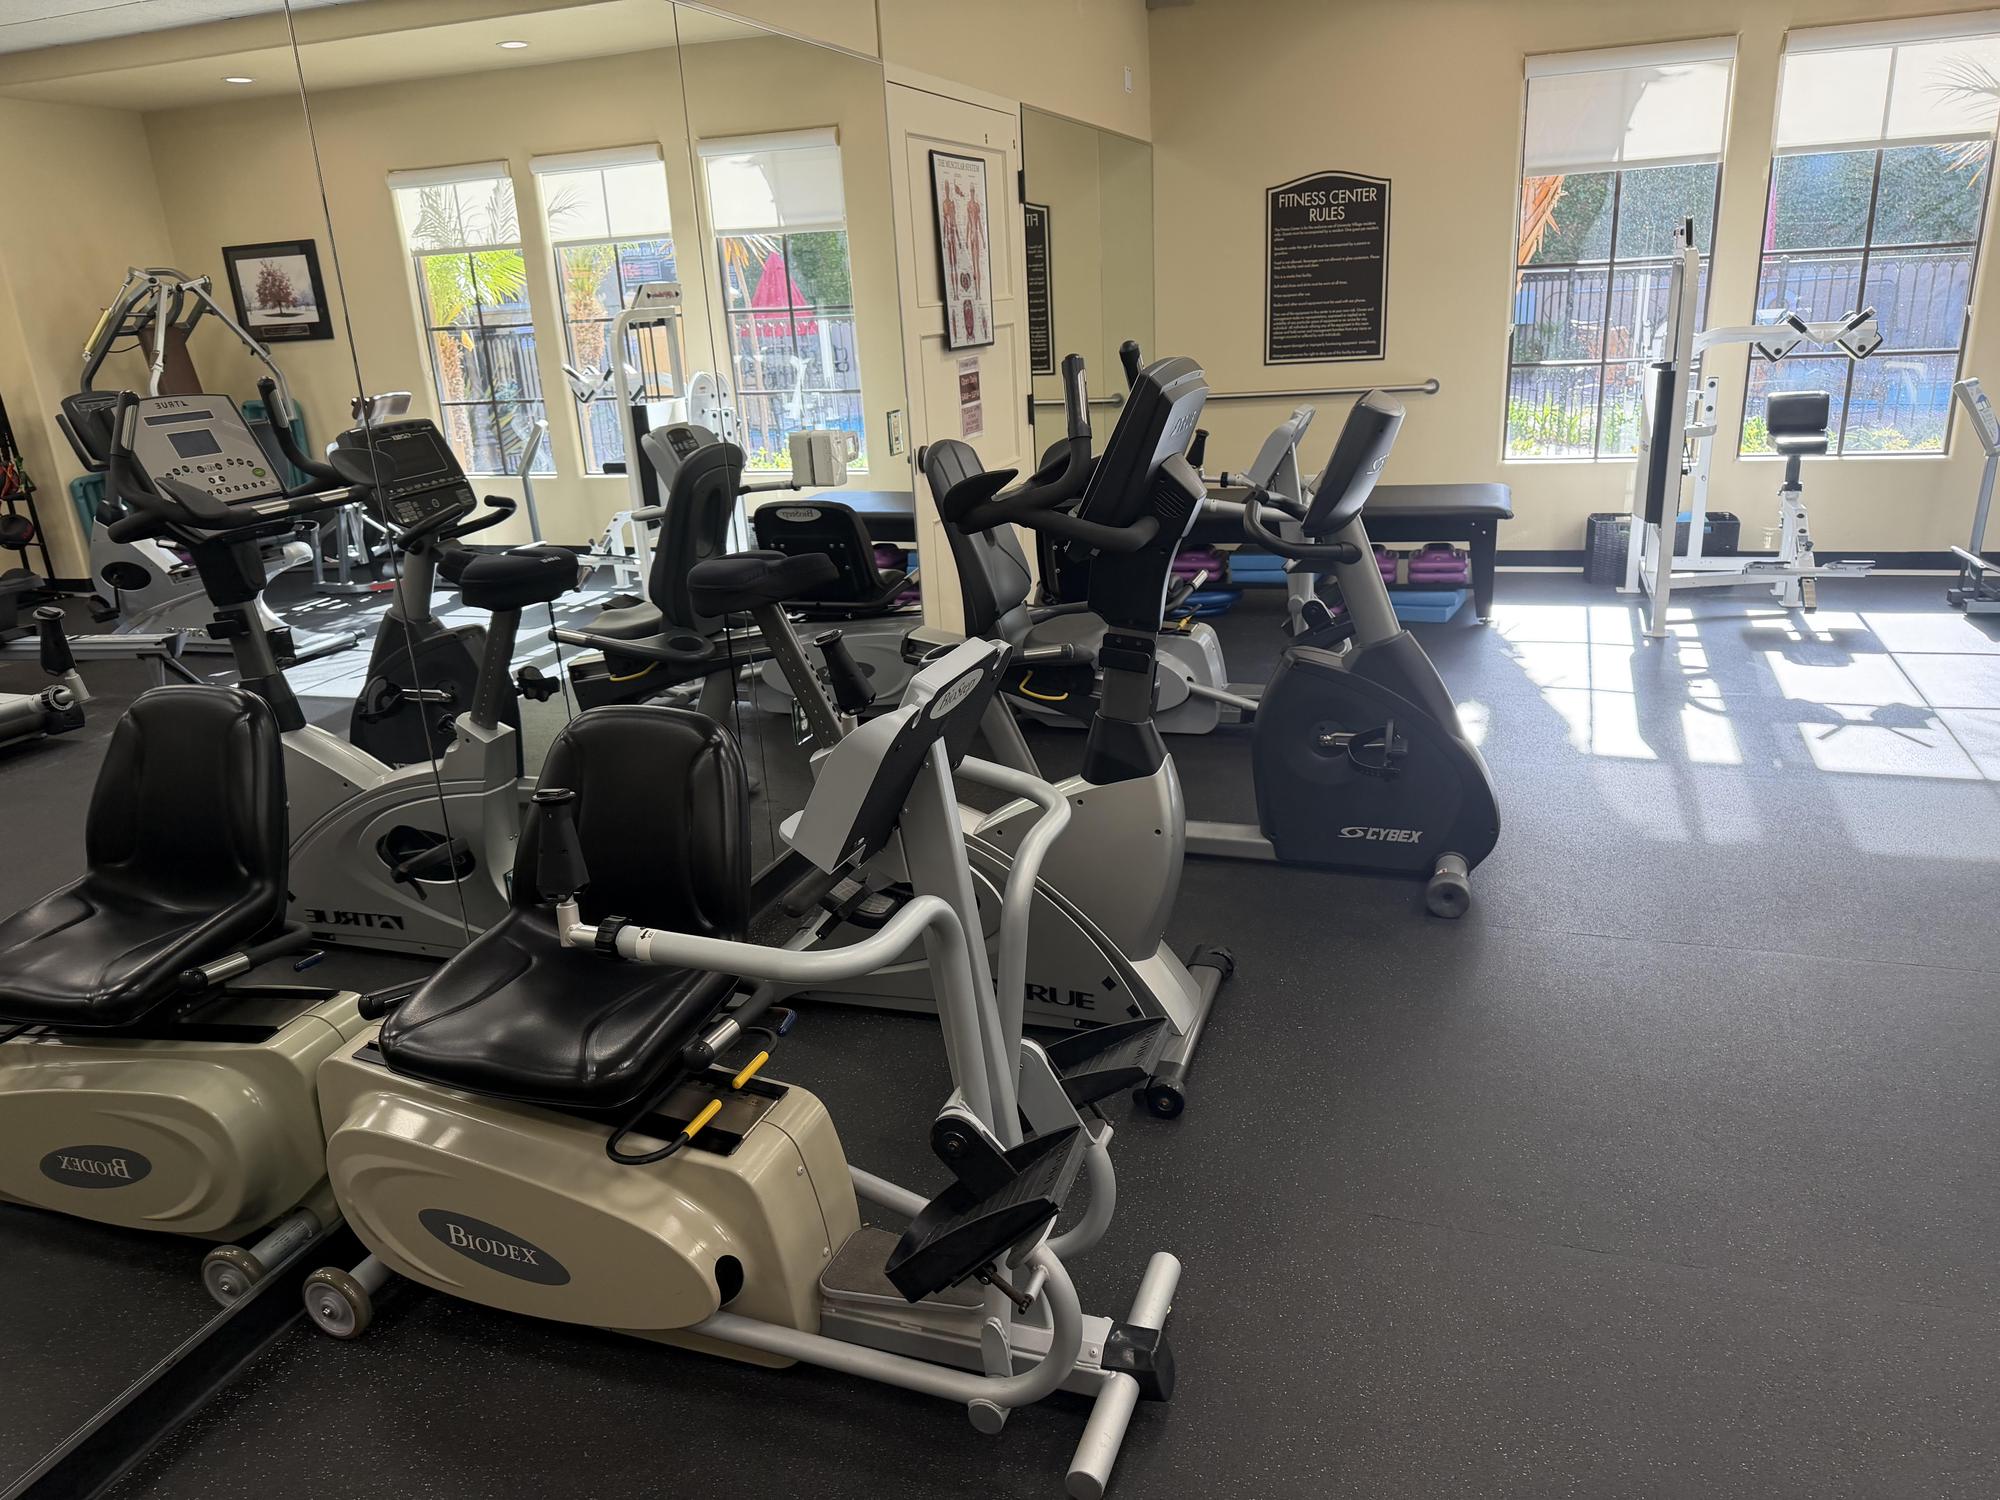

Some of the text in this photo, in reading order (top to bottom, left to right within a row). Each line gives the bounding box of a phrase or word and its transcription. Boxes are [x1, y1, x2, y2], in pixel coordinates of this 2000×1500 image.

[1279, 187, 1377, 208] FITNESS CENTER
[1309, 206, 1345, 222] RULES
[1365, 827, 1424, 844] CYBEX
[1024, 983, 1096, 1011] RUE
